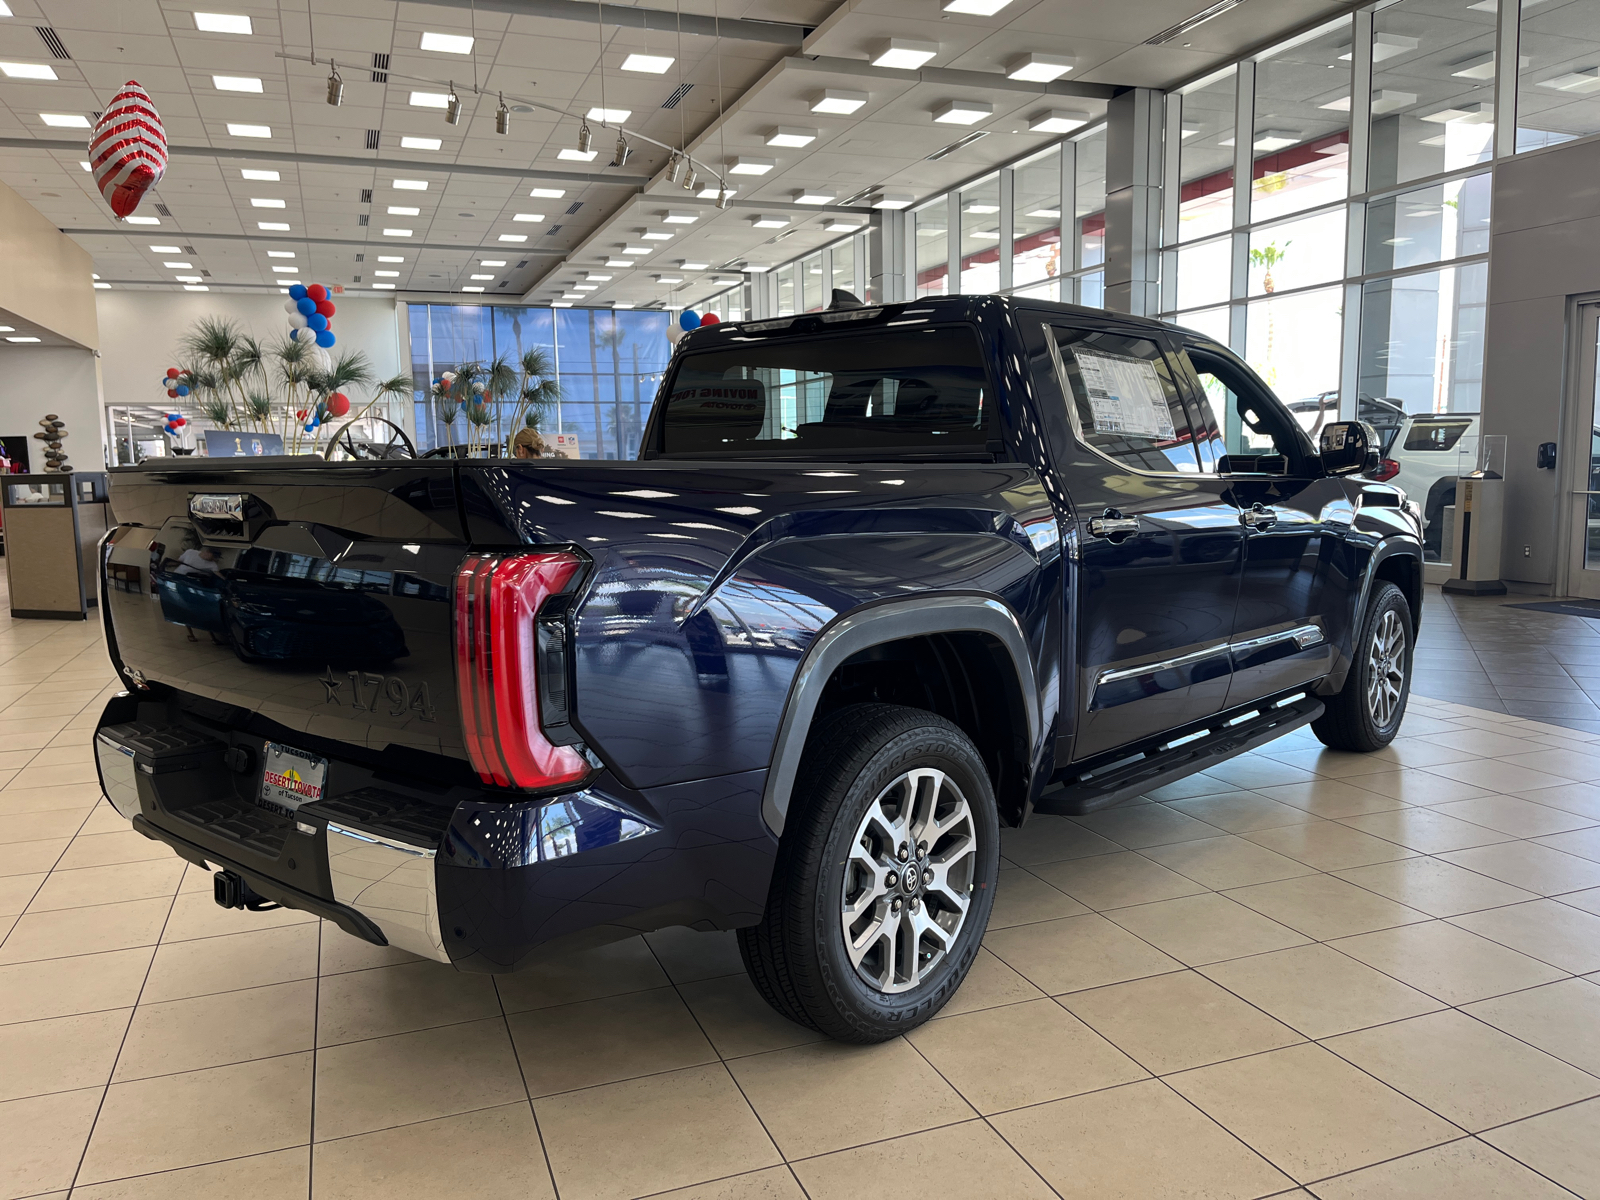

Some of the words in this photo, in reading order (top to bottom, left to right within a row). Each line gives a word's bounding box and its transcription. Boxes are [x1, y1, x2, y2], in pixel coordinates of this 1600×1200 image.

[347, 670, 437, 723] 1794
[280, 745, 312, 760] TUCSON
[264, 771, 292, 790] DESERT
[293, 779, 321, 799] TOYOTA
[278, 789, 284, 797] of
[285, 791, 303, 803] Tucson
[258, 800, 283, 815] DESERT
